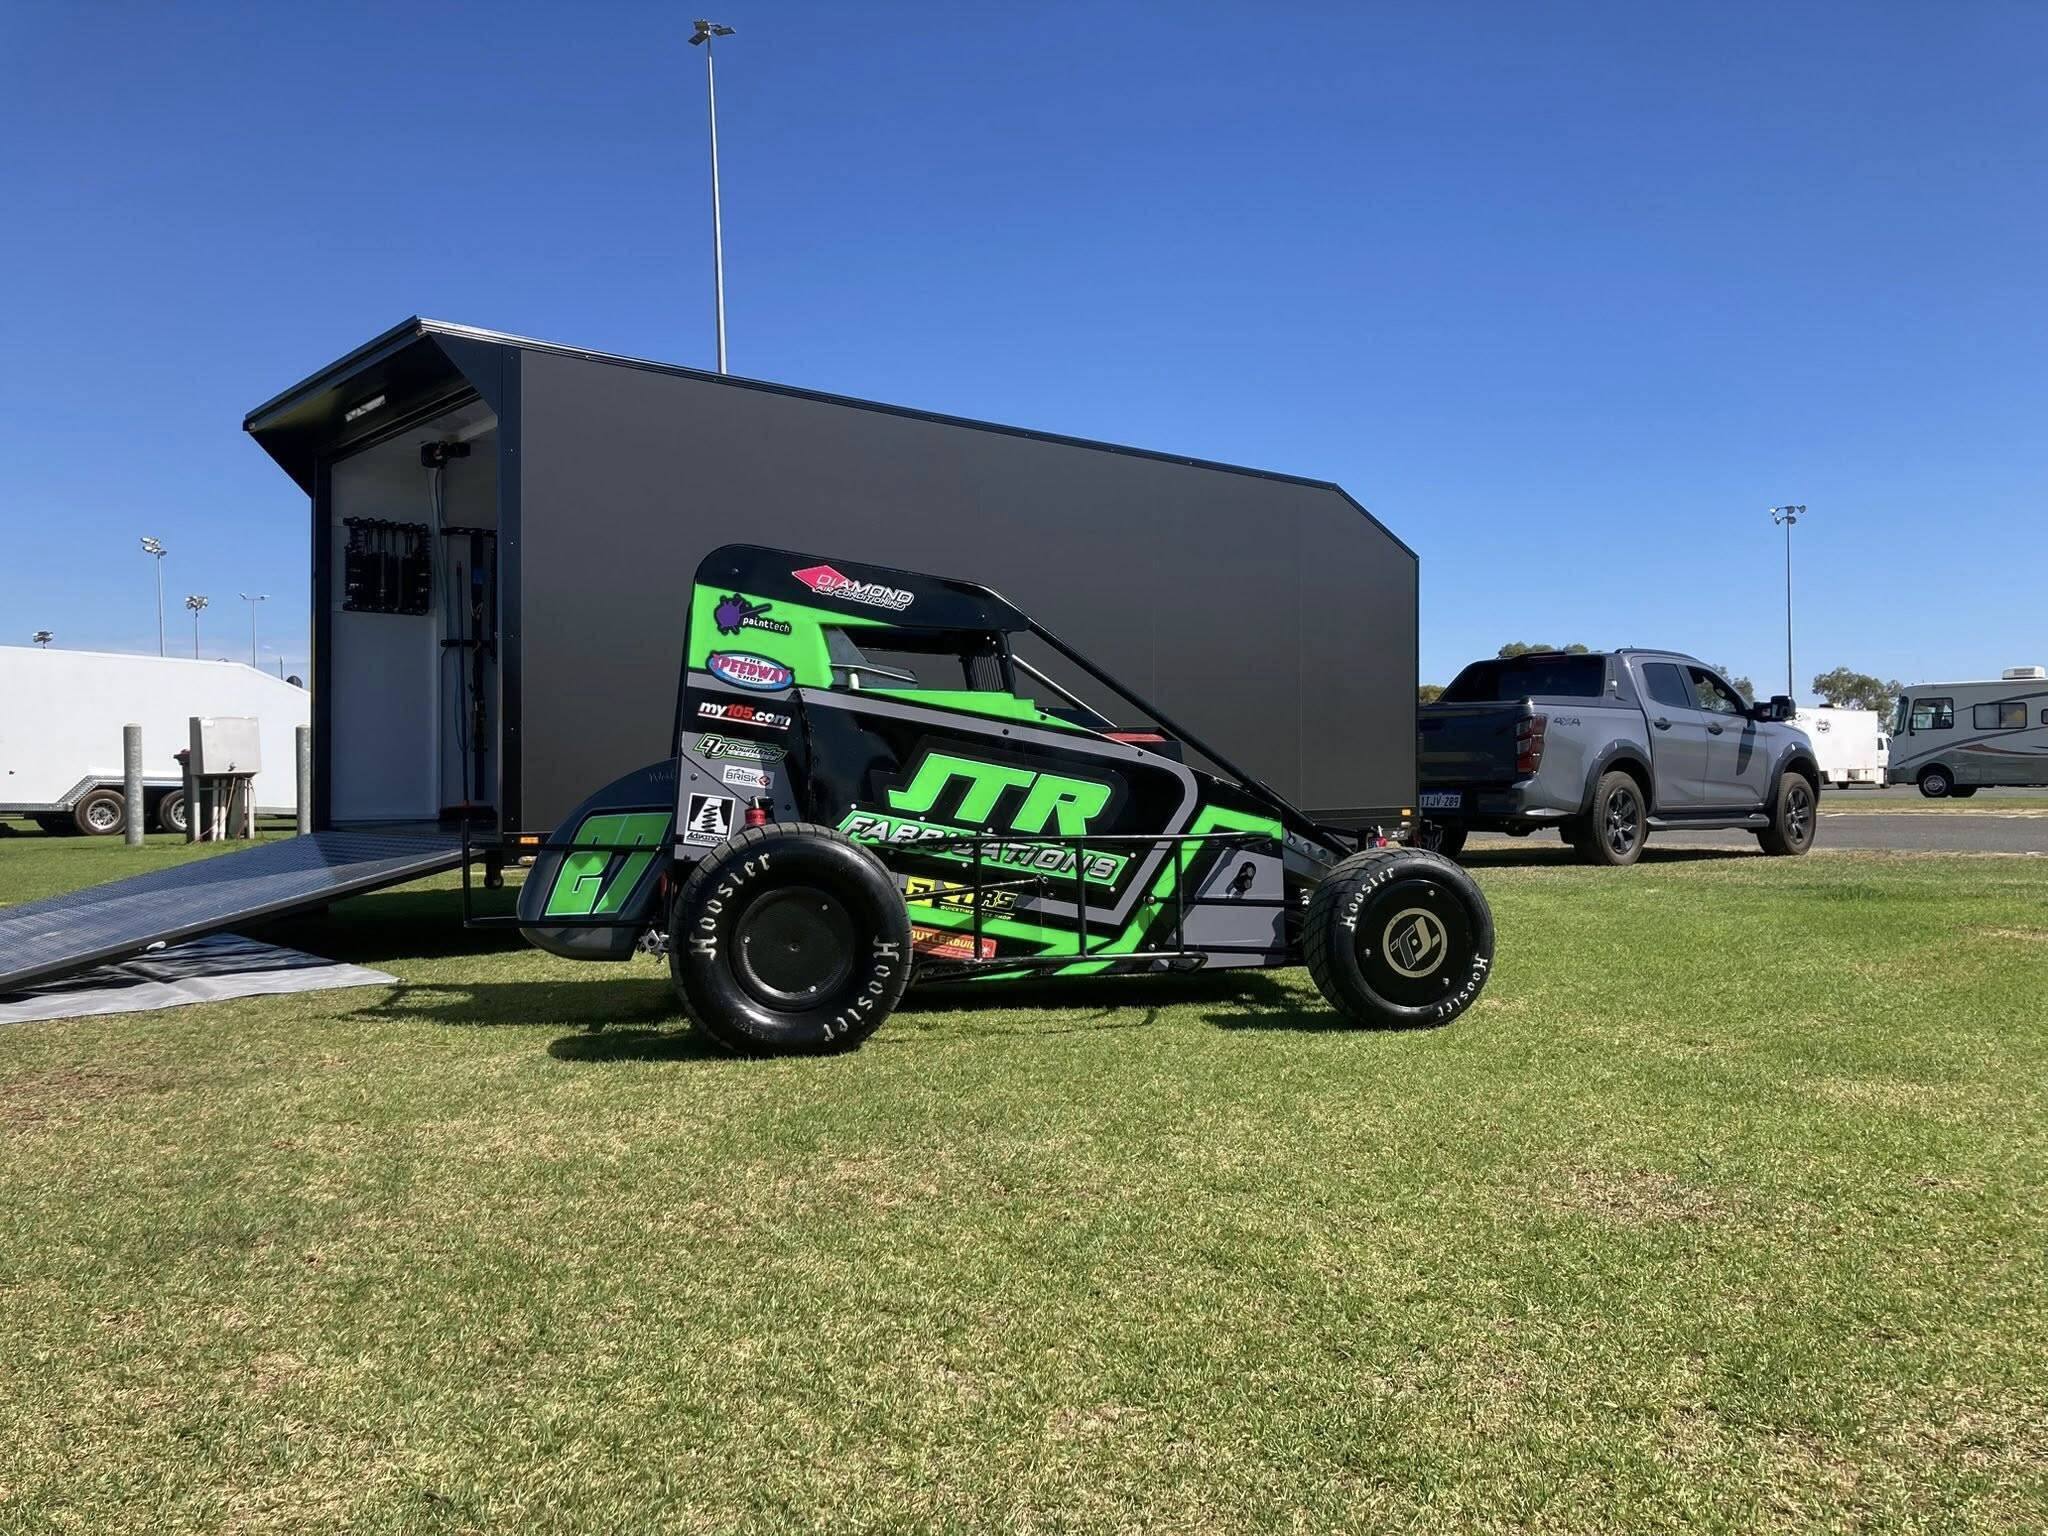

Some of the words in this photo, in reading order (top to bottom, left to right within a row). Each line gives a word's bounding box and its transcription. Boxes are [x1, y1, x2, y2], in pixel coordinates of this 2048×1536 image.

[816, 574, 914, 603] DIAMOND
[816, 585, 834, 595] AIR
[836, 588, 905, 609] CONDITIONING
[742, 617, 790, 633] painttech
[712, 654, 790, 684] SPEEDWAY
[744, 657, 761, 665] THE
[737, 674, 764, 683] SHOP
[699, 702, 792, 726] my105.com
[888, 752, 1112, 836] JTR
[686, 831, 728, 842] Advanced
[688, 852, 770, 961] Hoosier
[1340, 867, 1395, 933] Hoosier
[911, 930, 975, 950] BUTLERBUIL
[823, 935, 900, 1042] Hoosier
[1437, 953, 1489, 1018] Hoosier
